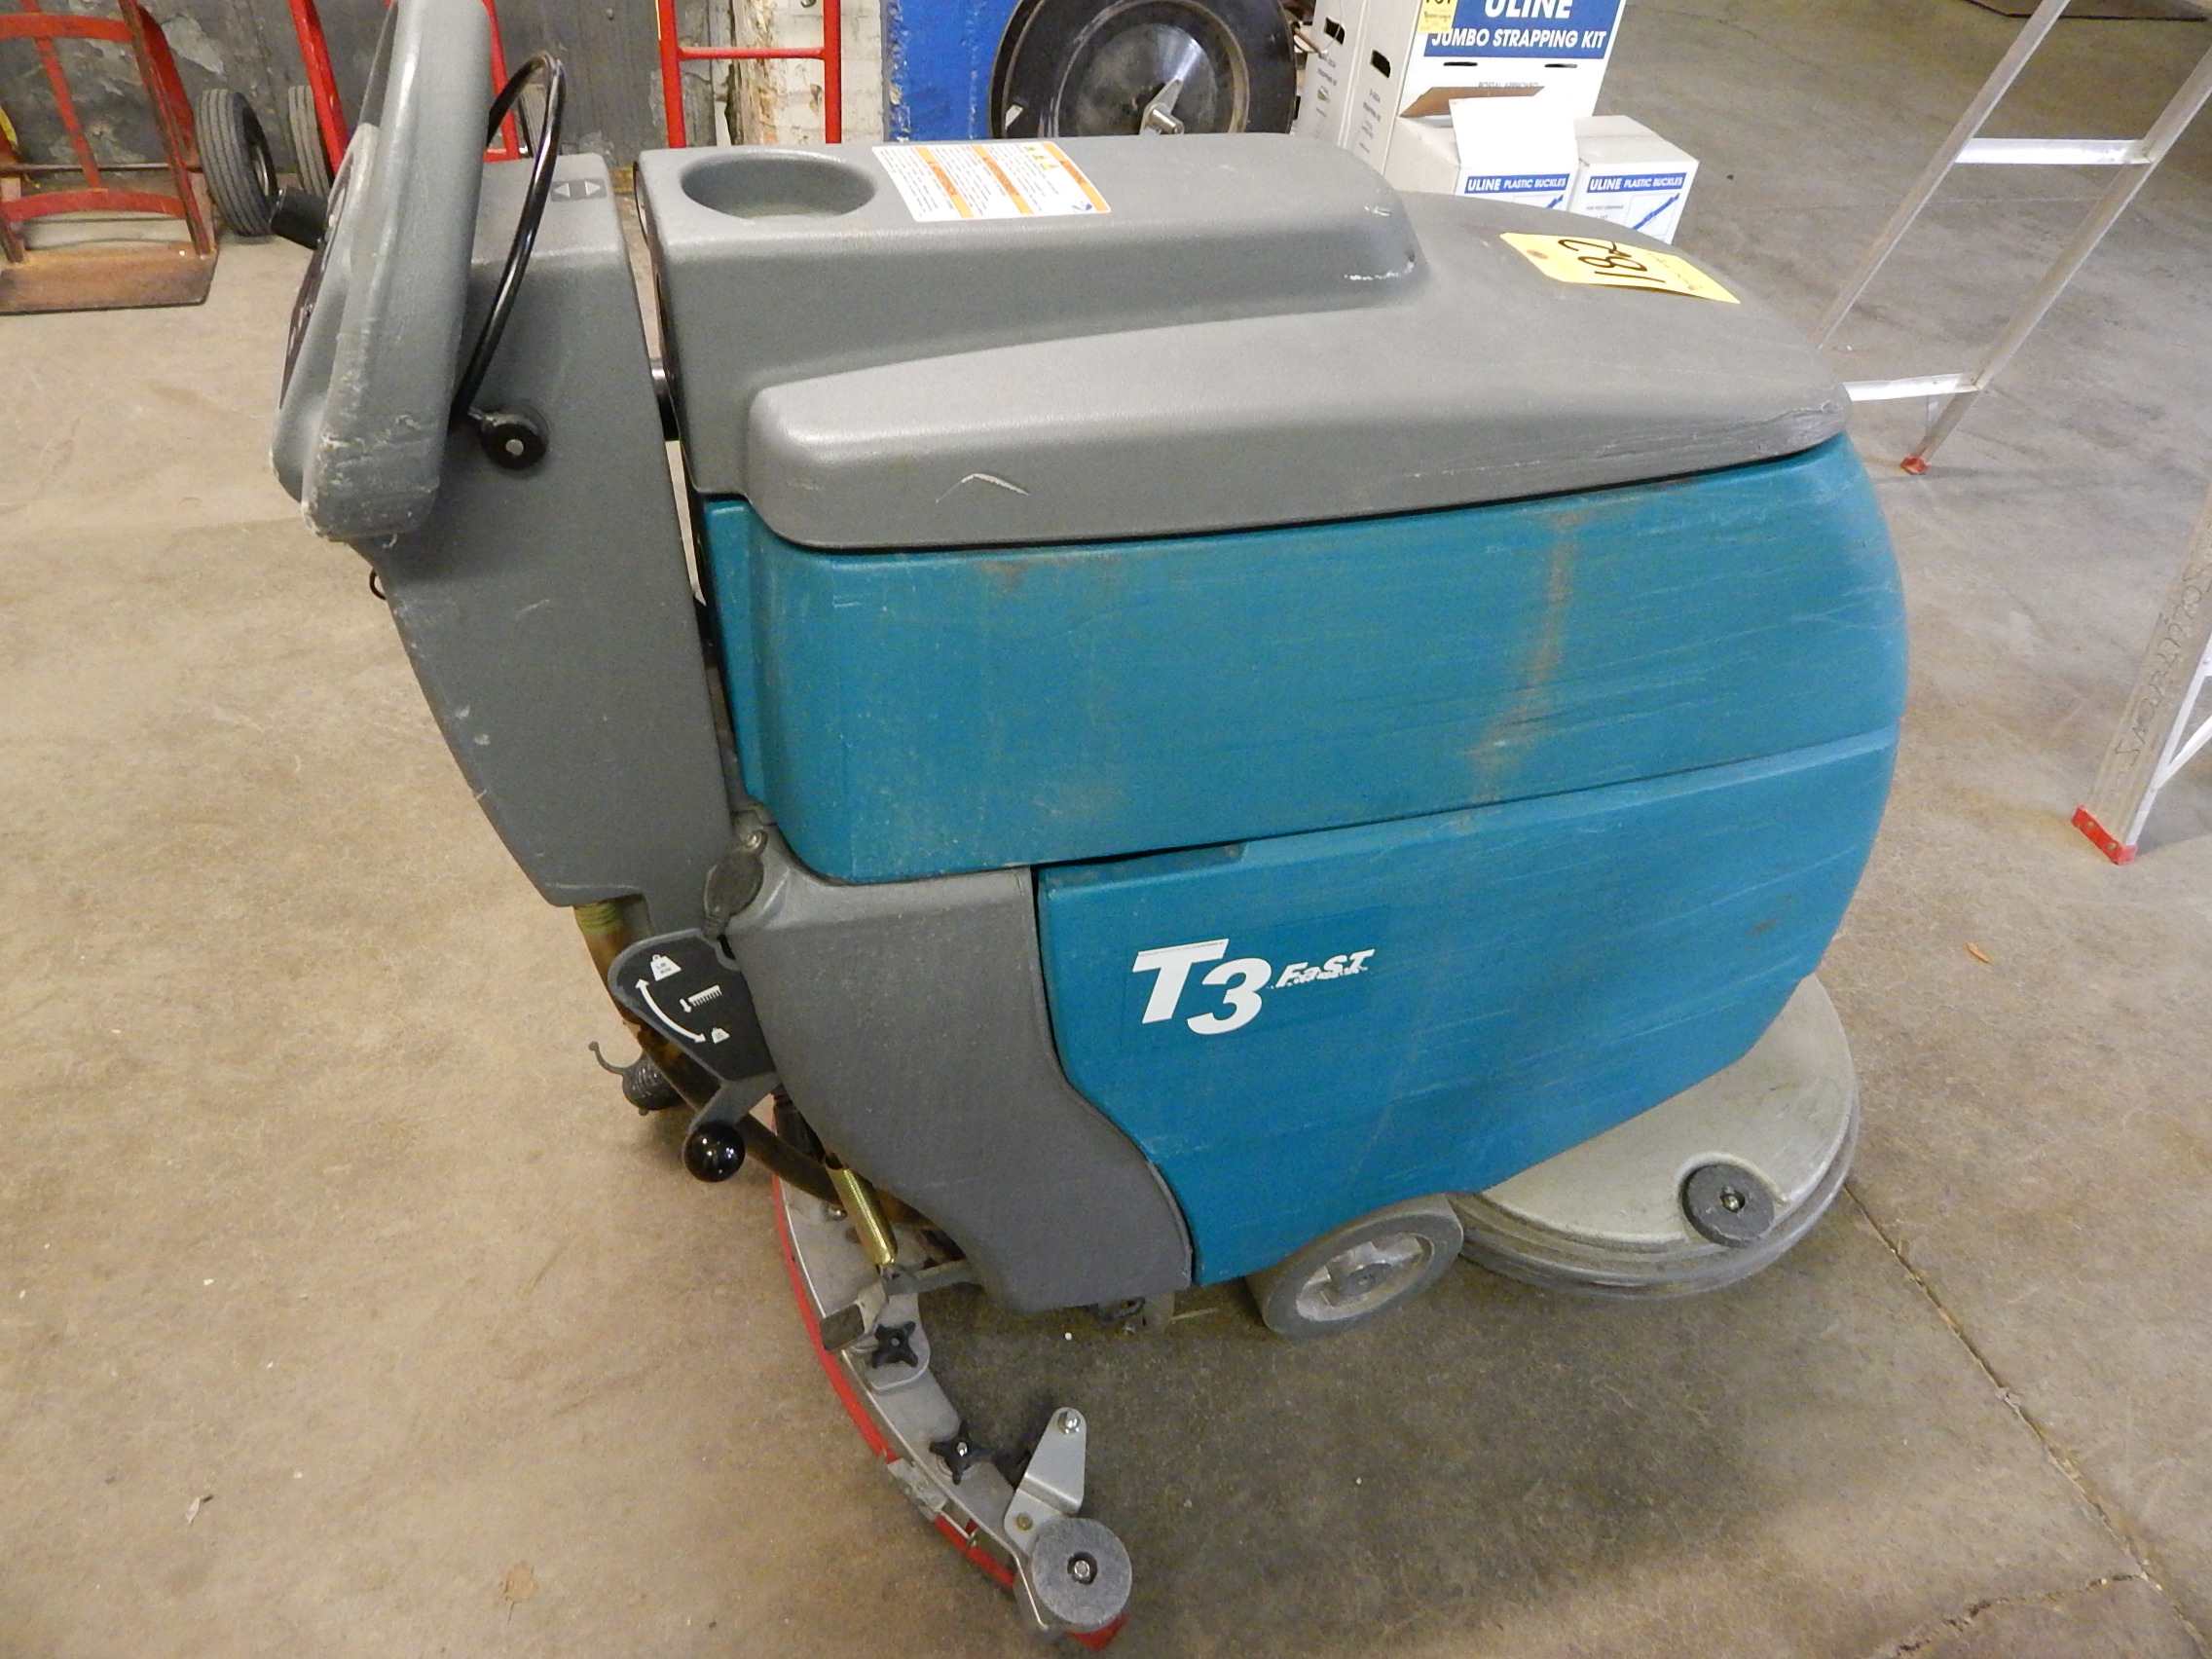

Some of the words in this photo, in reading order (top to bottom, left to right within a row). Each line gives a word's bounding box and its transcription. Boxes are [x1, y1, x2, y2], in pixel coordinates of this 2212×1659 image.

[1485, 0, 1573, 18] ULINE
[1431, 28, 1491, 47] JUMBO
[1493, 28, 1578, 48] STRAPPING
[1581, 30, 1607, 49] KIT
[1467, 178, 1501, 192] ULINE
[1503, 179, 1533, 189] PLASTIC
[1534, 177, 1567, 188] BUCKLES
[1589, 177, 1622, 191] ULINE
[1623, 177, 1652, 188] PLASTIC
[1652, 176, 1683, 187] BUCKLES
[1558, 240, 1667, 283] 182
[1132, 938, 1272, 1035] T3
